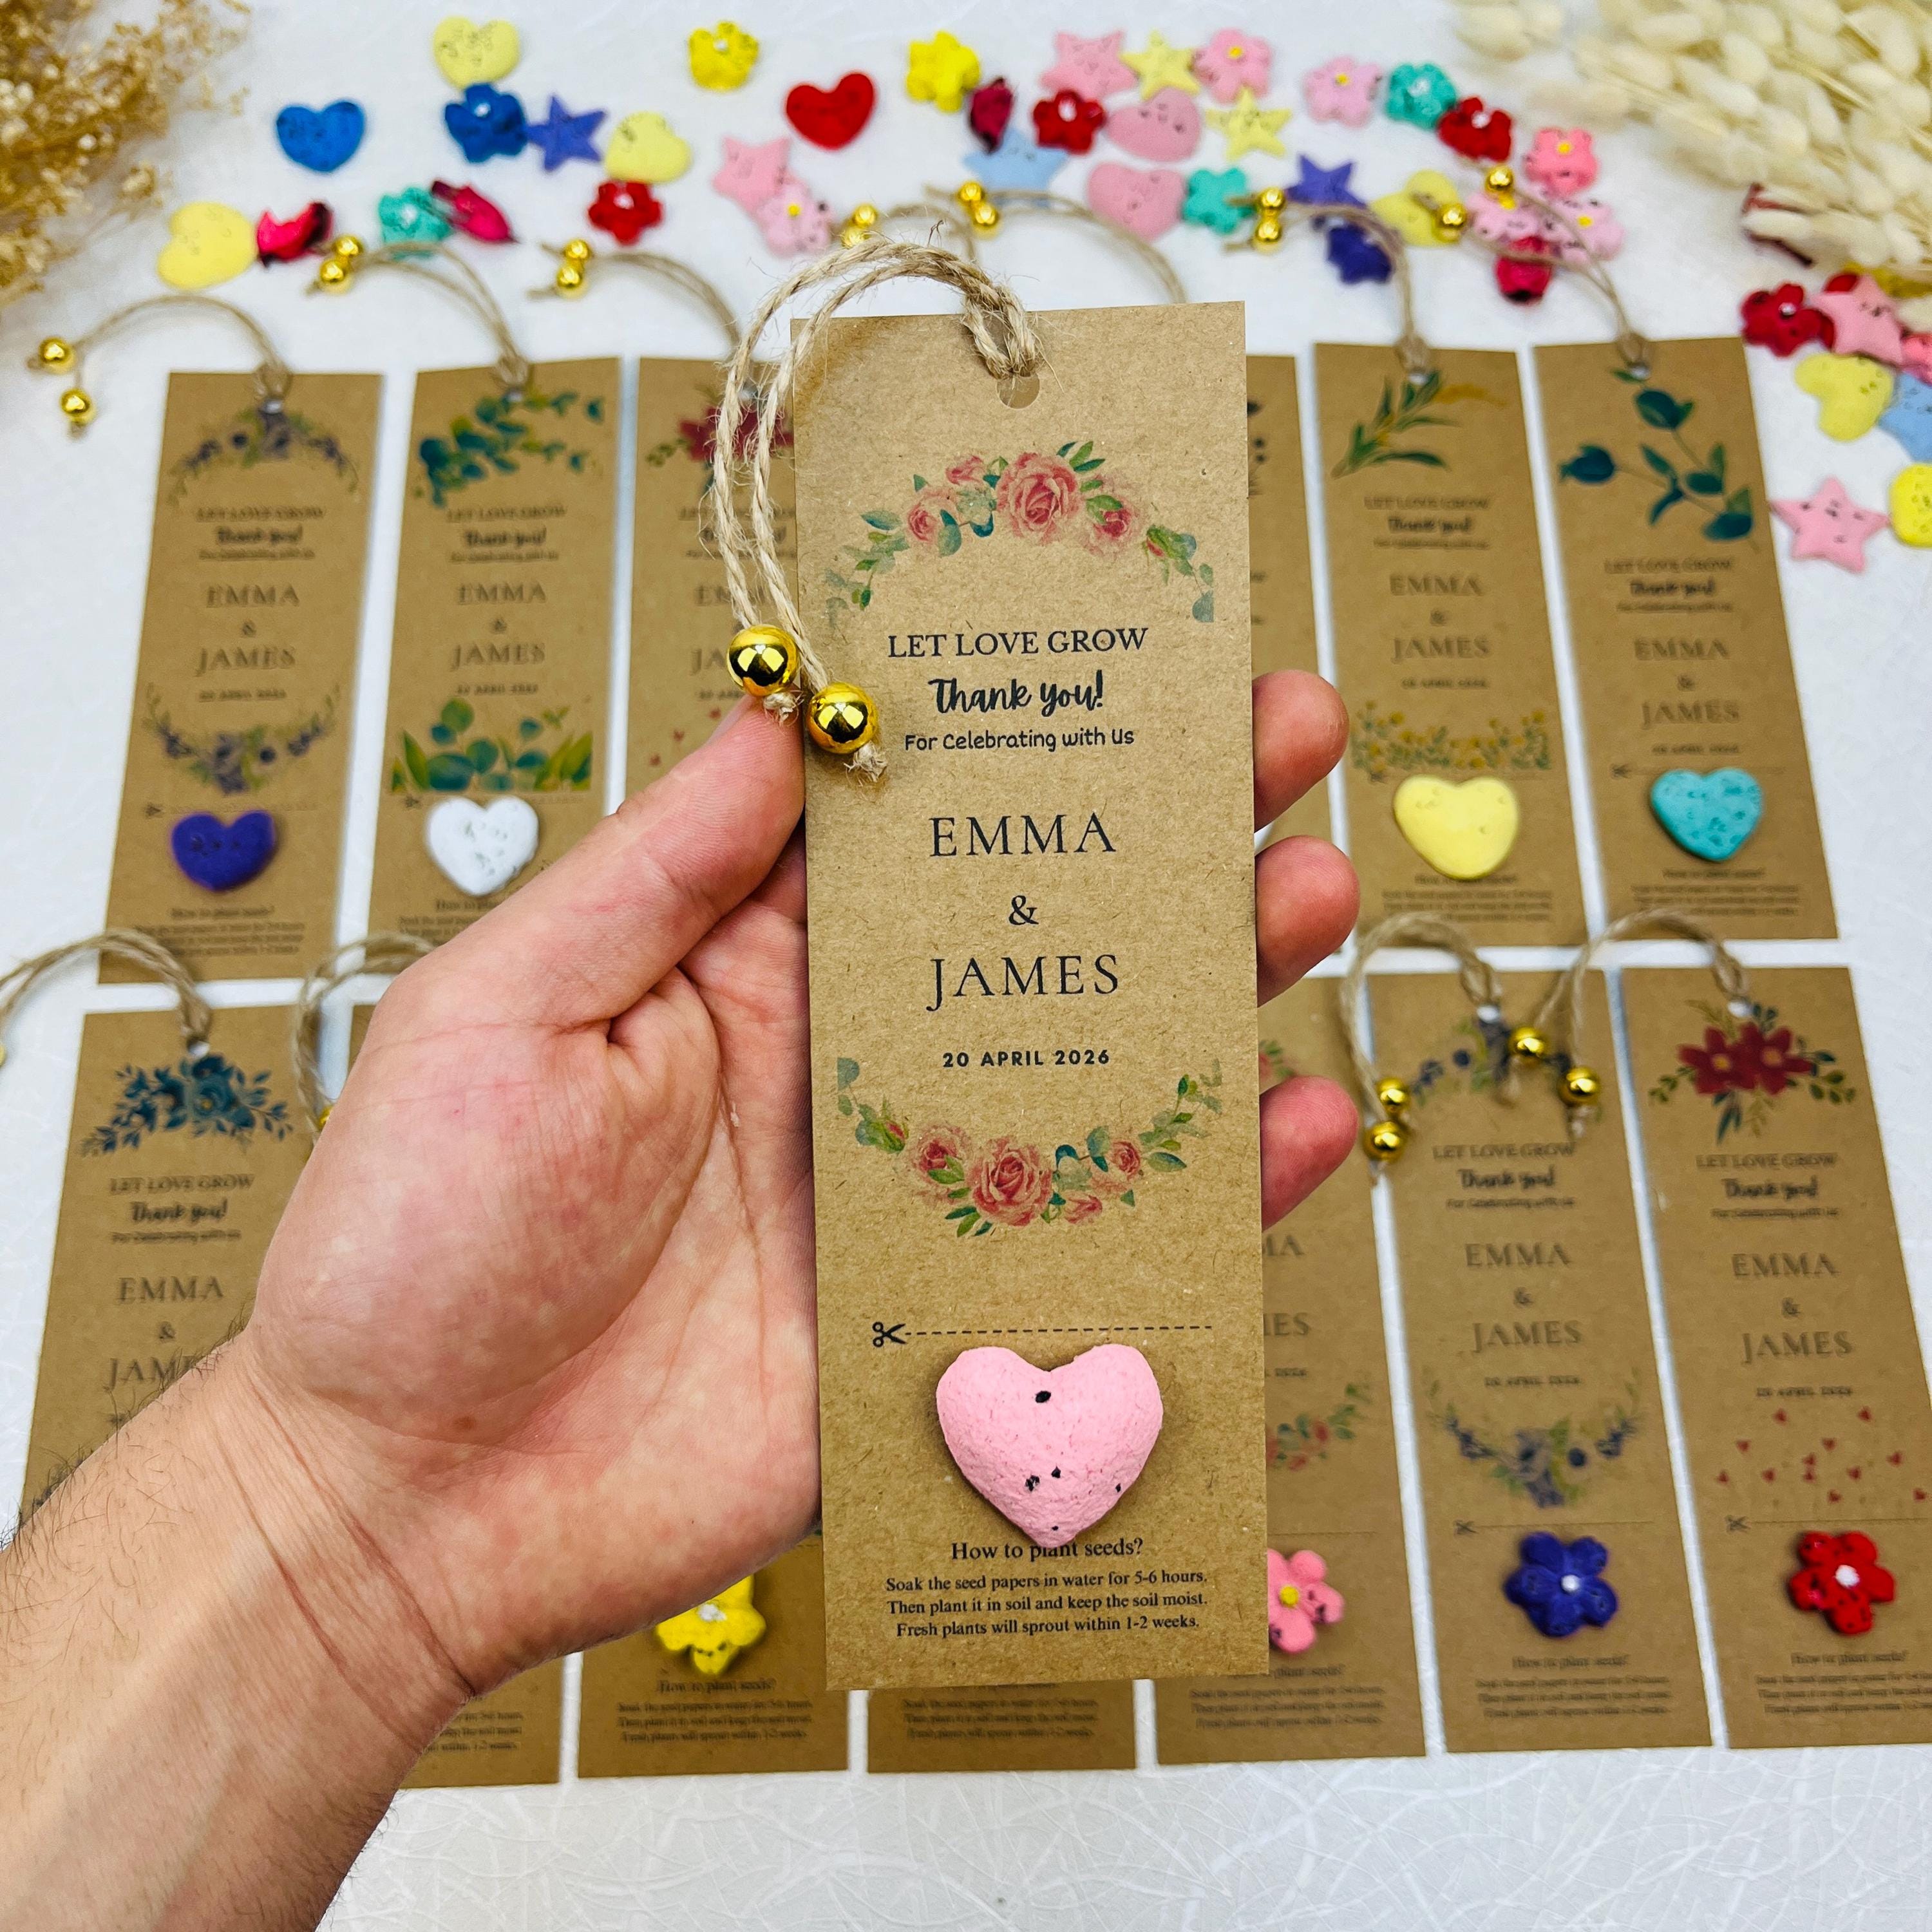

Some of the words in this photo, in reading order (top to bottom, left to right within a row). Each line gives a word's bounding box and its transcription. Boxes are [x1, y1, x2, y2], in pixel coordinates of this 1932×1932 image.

[887, 633, 948, 658] LET
[954, 630, 1039, 657] LOVE
[1046, 627, 1150, 654] GROW
[1390, 636, 1492, 665] JAMES
[927, 677, 1033, 715] Thank
[1039, 668, 1104, 718] you!
[1641, 699, 1741, 730] JAMES
[904, 734, 939, 752] For
[942, 728, 1057, 753] Celebrating
[1061, 725, 1106, 748] with
[1111, 727, 1135, 746] Us
[927, 811, 1117, 858] EMMA
[1007, 894, 1040, 927] &
[925, 953, 1119, 1012] JAMES
[942, 1051, 970, 1068] 20
[980, 1050, 1045, 1068] APRIL
[1052, 1048, 1110, 1066] 2026
[1464, 1243, 1574, 1269] EMMA
[1732, 1253, 1841, 1278] EMMA
[118, 1276, 224, 1303] EMMA
[1472, 1321, 1583, 1354] JAMES
[1741, 1331, 1853, 1365] JAMES
[102, 1356, 198, 1391] JAM
[951, 1542, 999, 1561] How
[1003, 1541, 1024, 1558] to
[1029, 1541, 1079, 1562] plant
[1084, 1537, 1144, 1557] seeds?
[886, 1576, 923, 1592] Soak
[927, 1575, 952, 1591] the
[954, 1574, 987, 1590] seed
[990, 1577, 1041, 1593] papers
[1043, 1576, 1059, 1588] in
[1061, 1573, 1104, 1587] water
[1108, 1570, 1131, 1586] for
[1133, 1569, 1158, 1585] 5-6
[1160, 1569, 1208, 1584] hours.
[886, 1600, 926, 1615] Then
[929, 1598, 969, 1617] plant
[971, 1599, 983, 1613] it
[987, 1600, 1002, 1613] in
[1005, 1596, 1032, 1611] soil
[1034, 1595, 1064, 1611] and
[1067, 1595, 1103, 1613] keep
[1105, 1593, 1130, 1609] the
[1132, 1592, 1159, 1607] soil
[1162, 1592, 1208, 1607] moist.
[896, 1622, 938, 1638] Fresh
[942, 1620, 988, 1640] plants
[990, 1618, 1018, 1634] will
[1021, 1618, 1070, 1637] sprout
[1073, 1616, 1121, 1632] within
[1126, 1615, 1148, 1630] 1-2
[1151, 1613, 1200, 1630] weeks.
